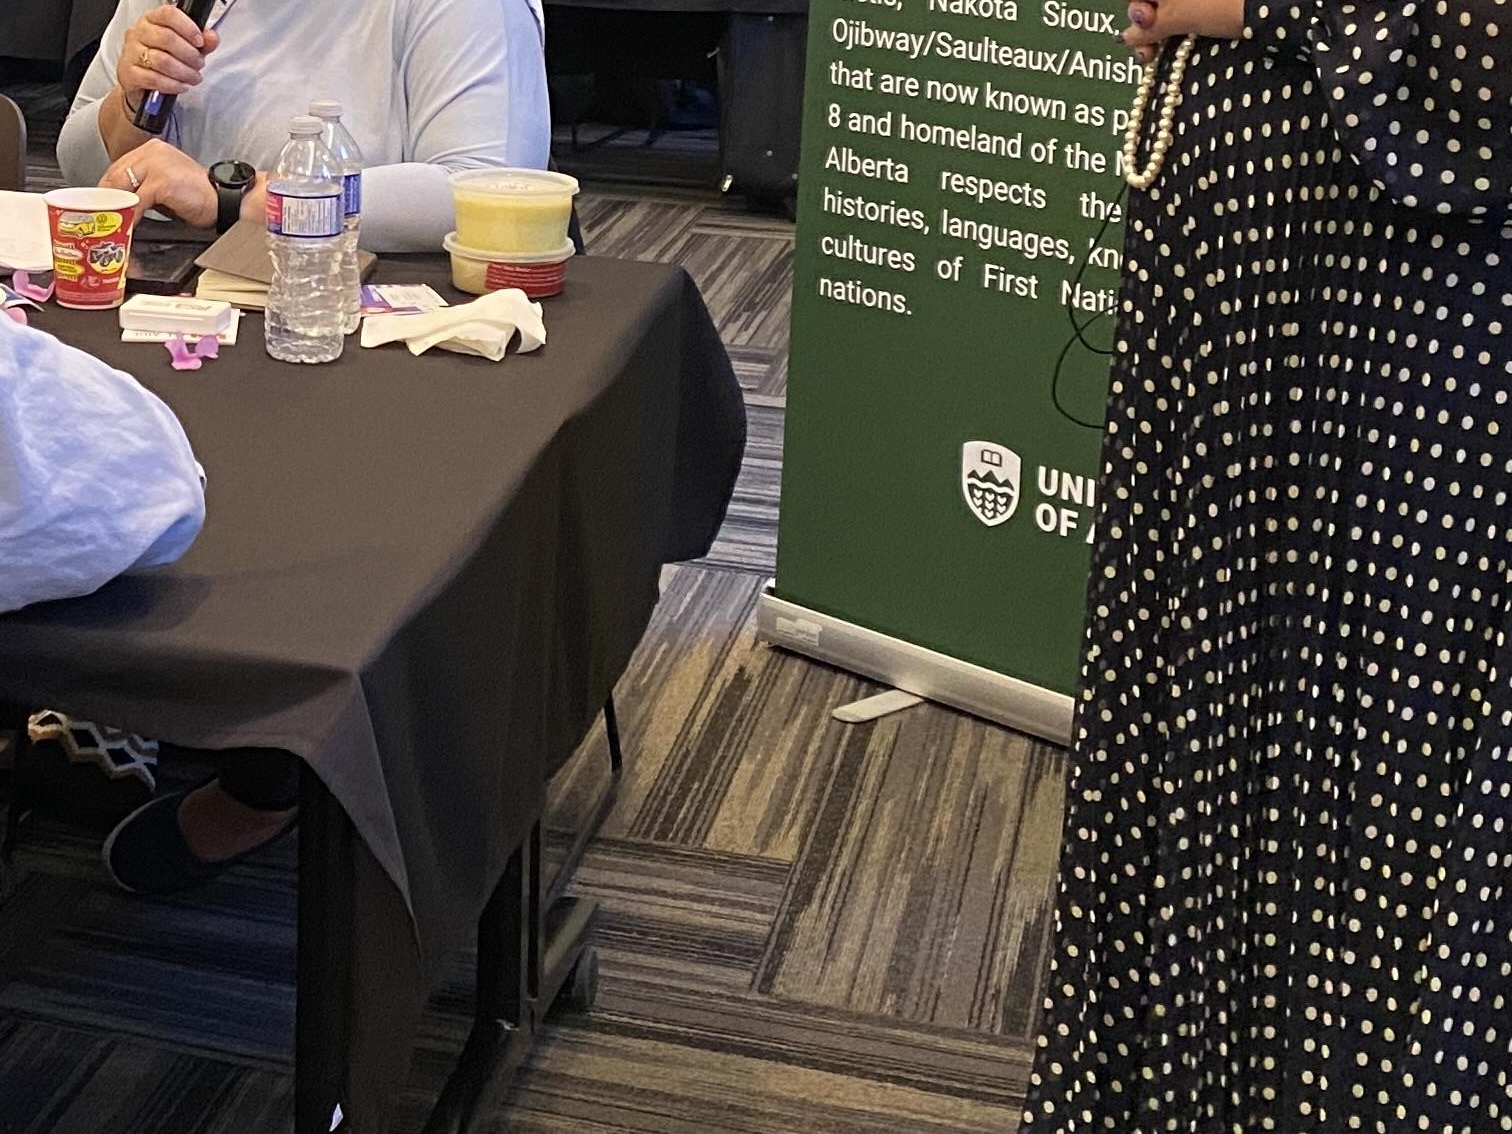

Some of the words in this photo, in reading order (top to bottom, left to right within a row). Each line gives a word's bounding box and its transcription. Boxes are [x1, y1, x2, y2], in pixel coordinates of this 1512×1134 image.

[1042, 0, 1120, 36] Sioux,
[829, 60, 874, 91] that
[880, 73, 920, 97] are
[926, 80, 979, 106] now
[985, 81, 1066, 121] known
[1074, 103, 1105, 127] as
[828, 103, 841, 128] 8
[848, 111, 892, 137] and
[900, 113, 1023, 159] homeland
[1030, 138, 1059, 165] of
[1064, 142, 1106, 173] the
[824, 145, 909, 183] Alberta
[941, 171, 1047, 209] respects
[1079, 191, 1122, 223] the
[823, 186, 930, 235] histories,
[941, 210, 1076, 264] languages,
[1088, 237, 1124, 270] kn
[819, 277, 912, 315] nations.
[821, 234, 916, 272] cultures
[937, 256, 964, 282] of
[983, 263, 1039, 299] First
[1061, 279, 1118, 315] Nati
[1035, 502, 1079, 537] OF
